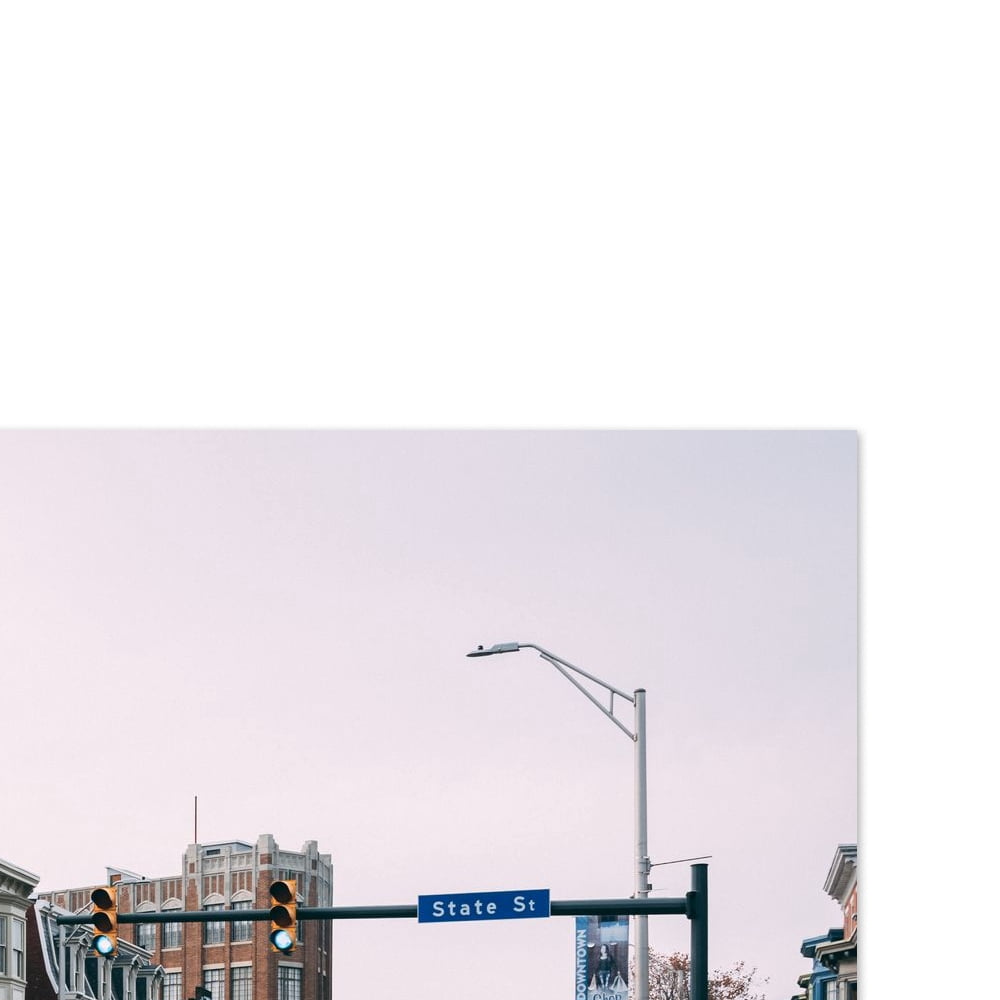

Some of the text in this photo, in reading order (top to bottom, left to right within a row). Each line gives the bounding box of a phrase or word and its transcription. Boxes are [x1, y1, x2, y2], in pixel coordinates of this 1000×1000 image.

[432, 895, 536, 917] State St
[577, 929, 587, 1000] DOWNTOWN
